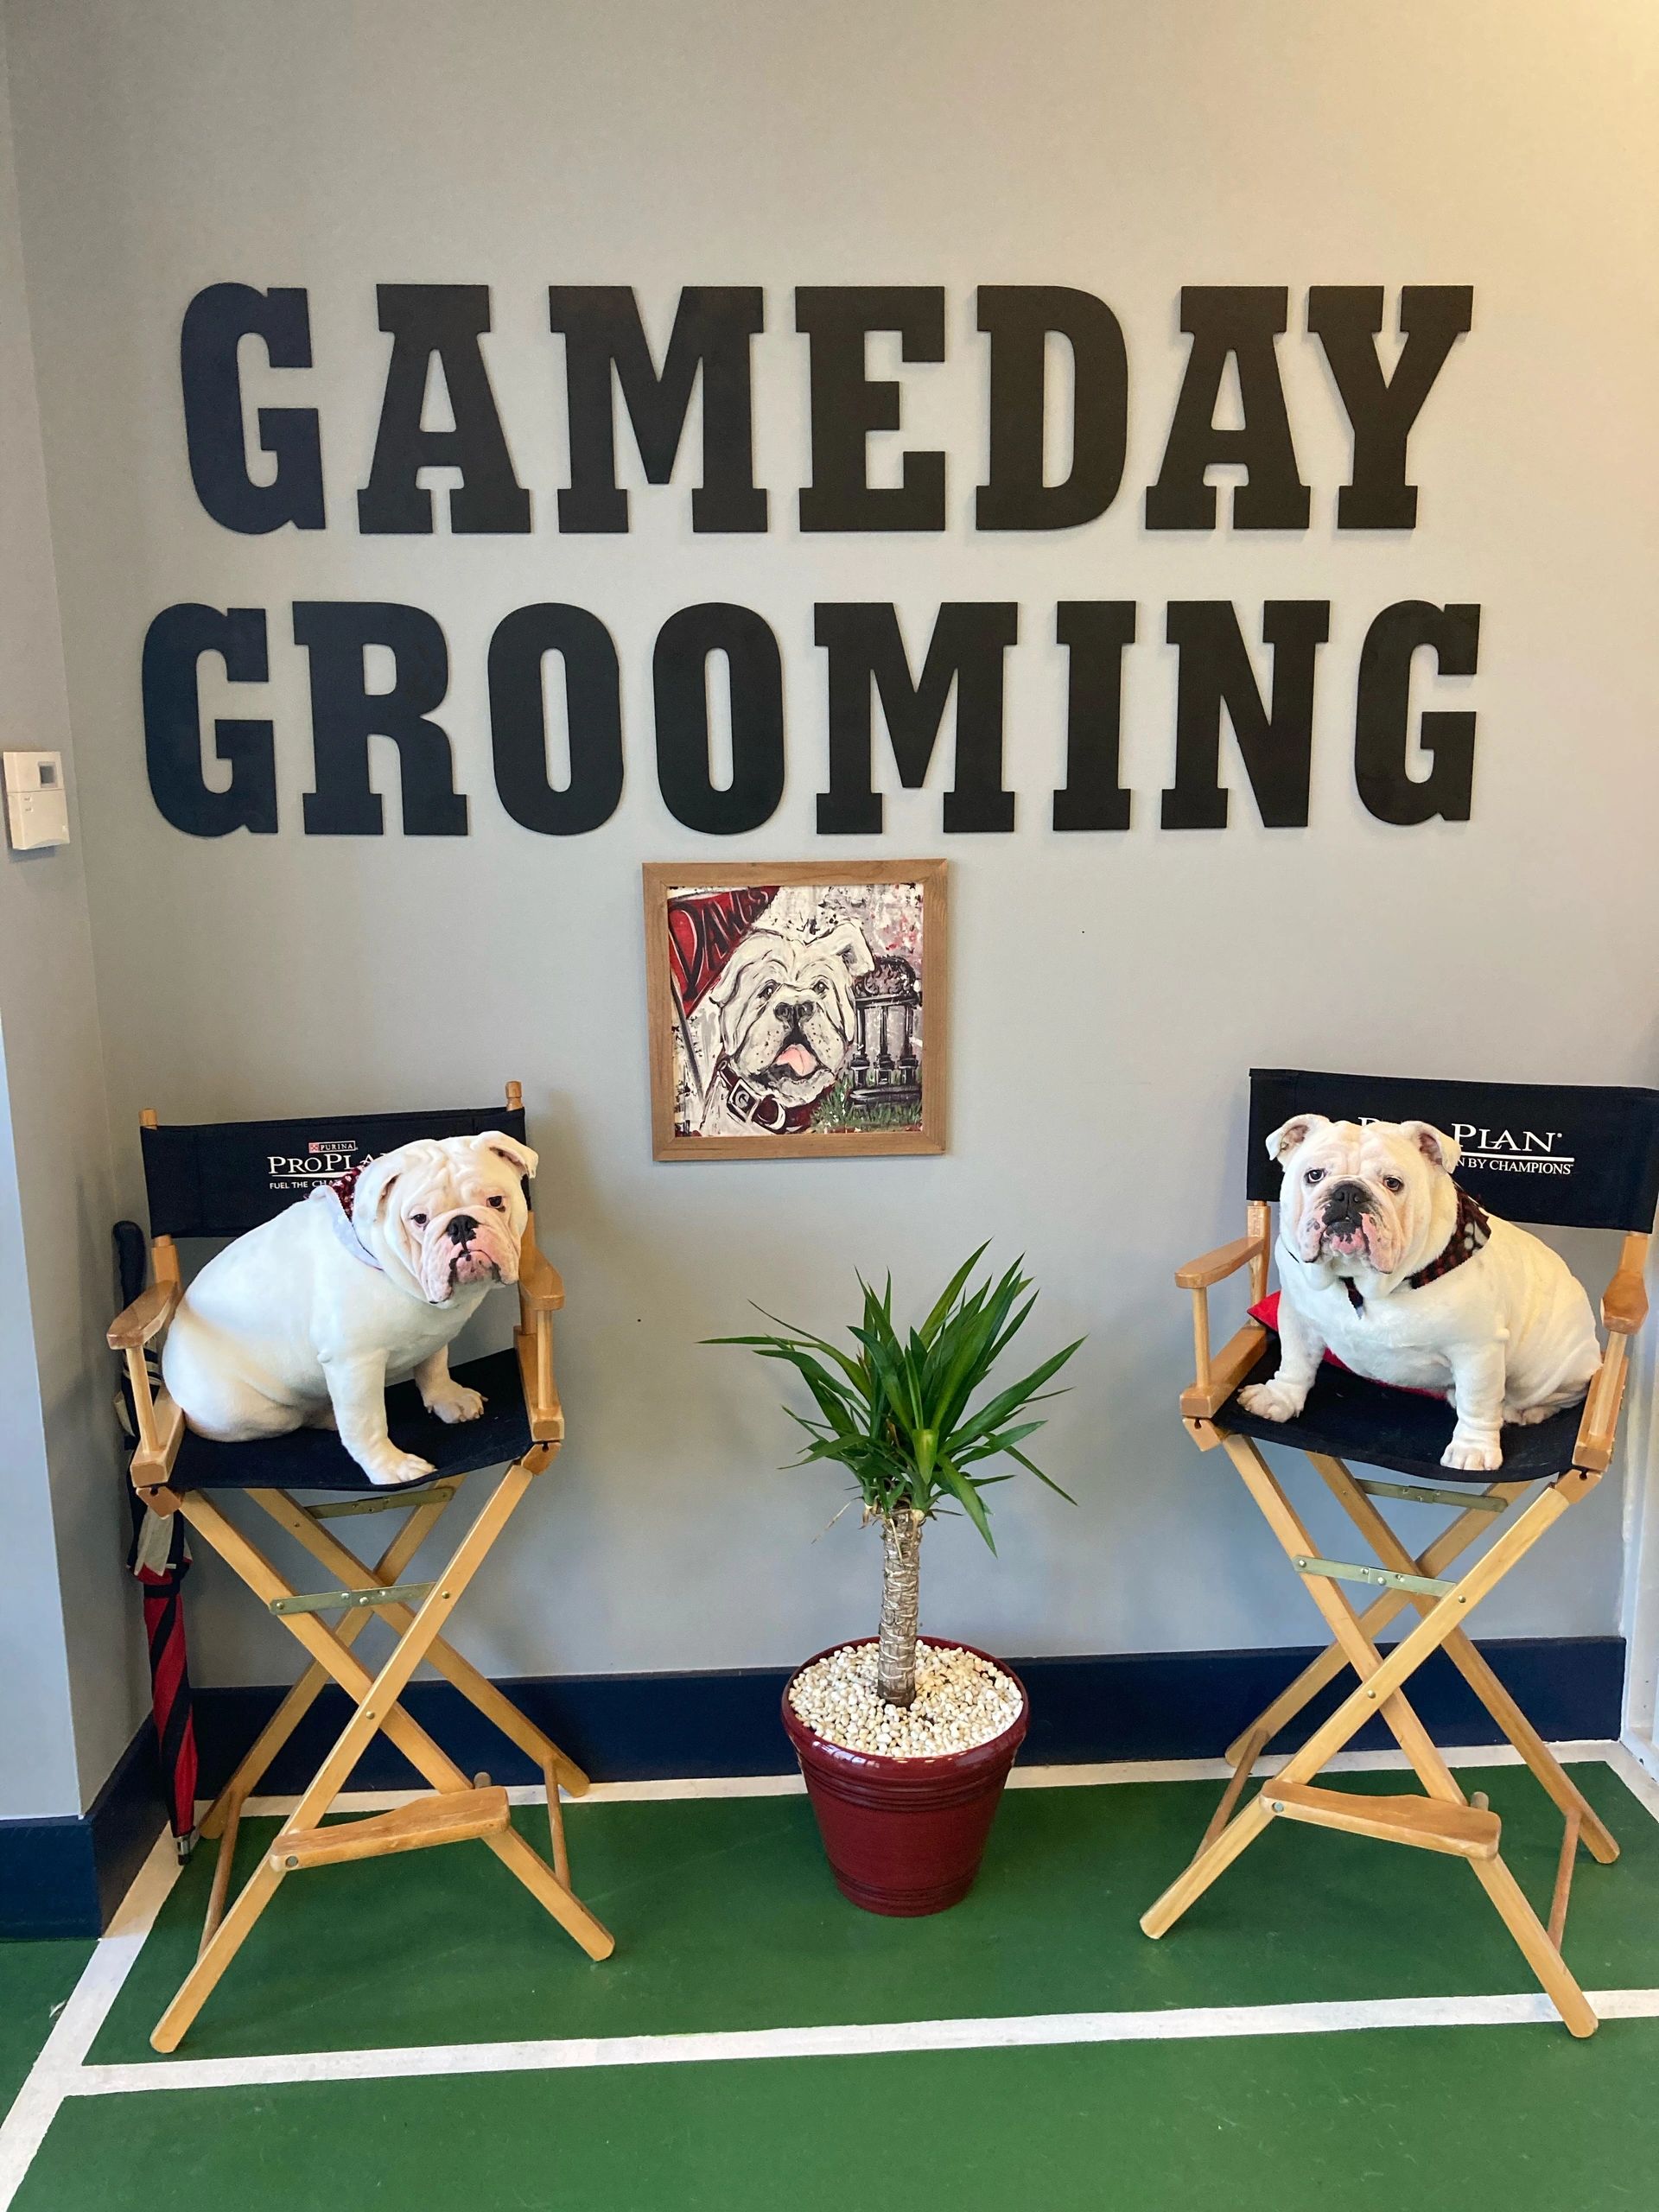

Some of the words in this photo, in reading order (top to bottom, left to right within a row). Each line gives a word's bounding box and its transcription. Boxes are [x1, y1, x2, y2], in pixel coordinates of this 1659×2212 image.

[180, 282, 1474, 535] GAMEDAY
[142, 601, 1483, 837] GROOMING
[1452, 1123, 1556, 1153] PLAN
[1468, 1158, 1488, 1169] BY
[1490, 1160, 1571, 1175] CHAMPIONS
